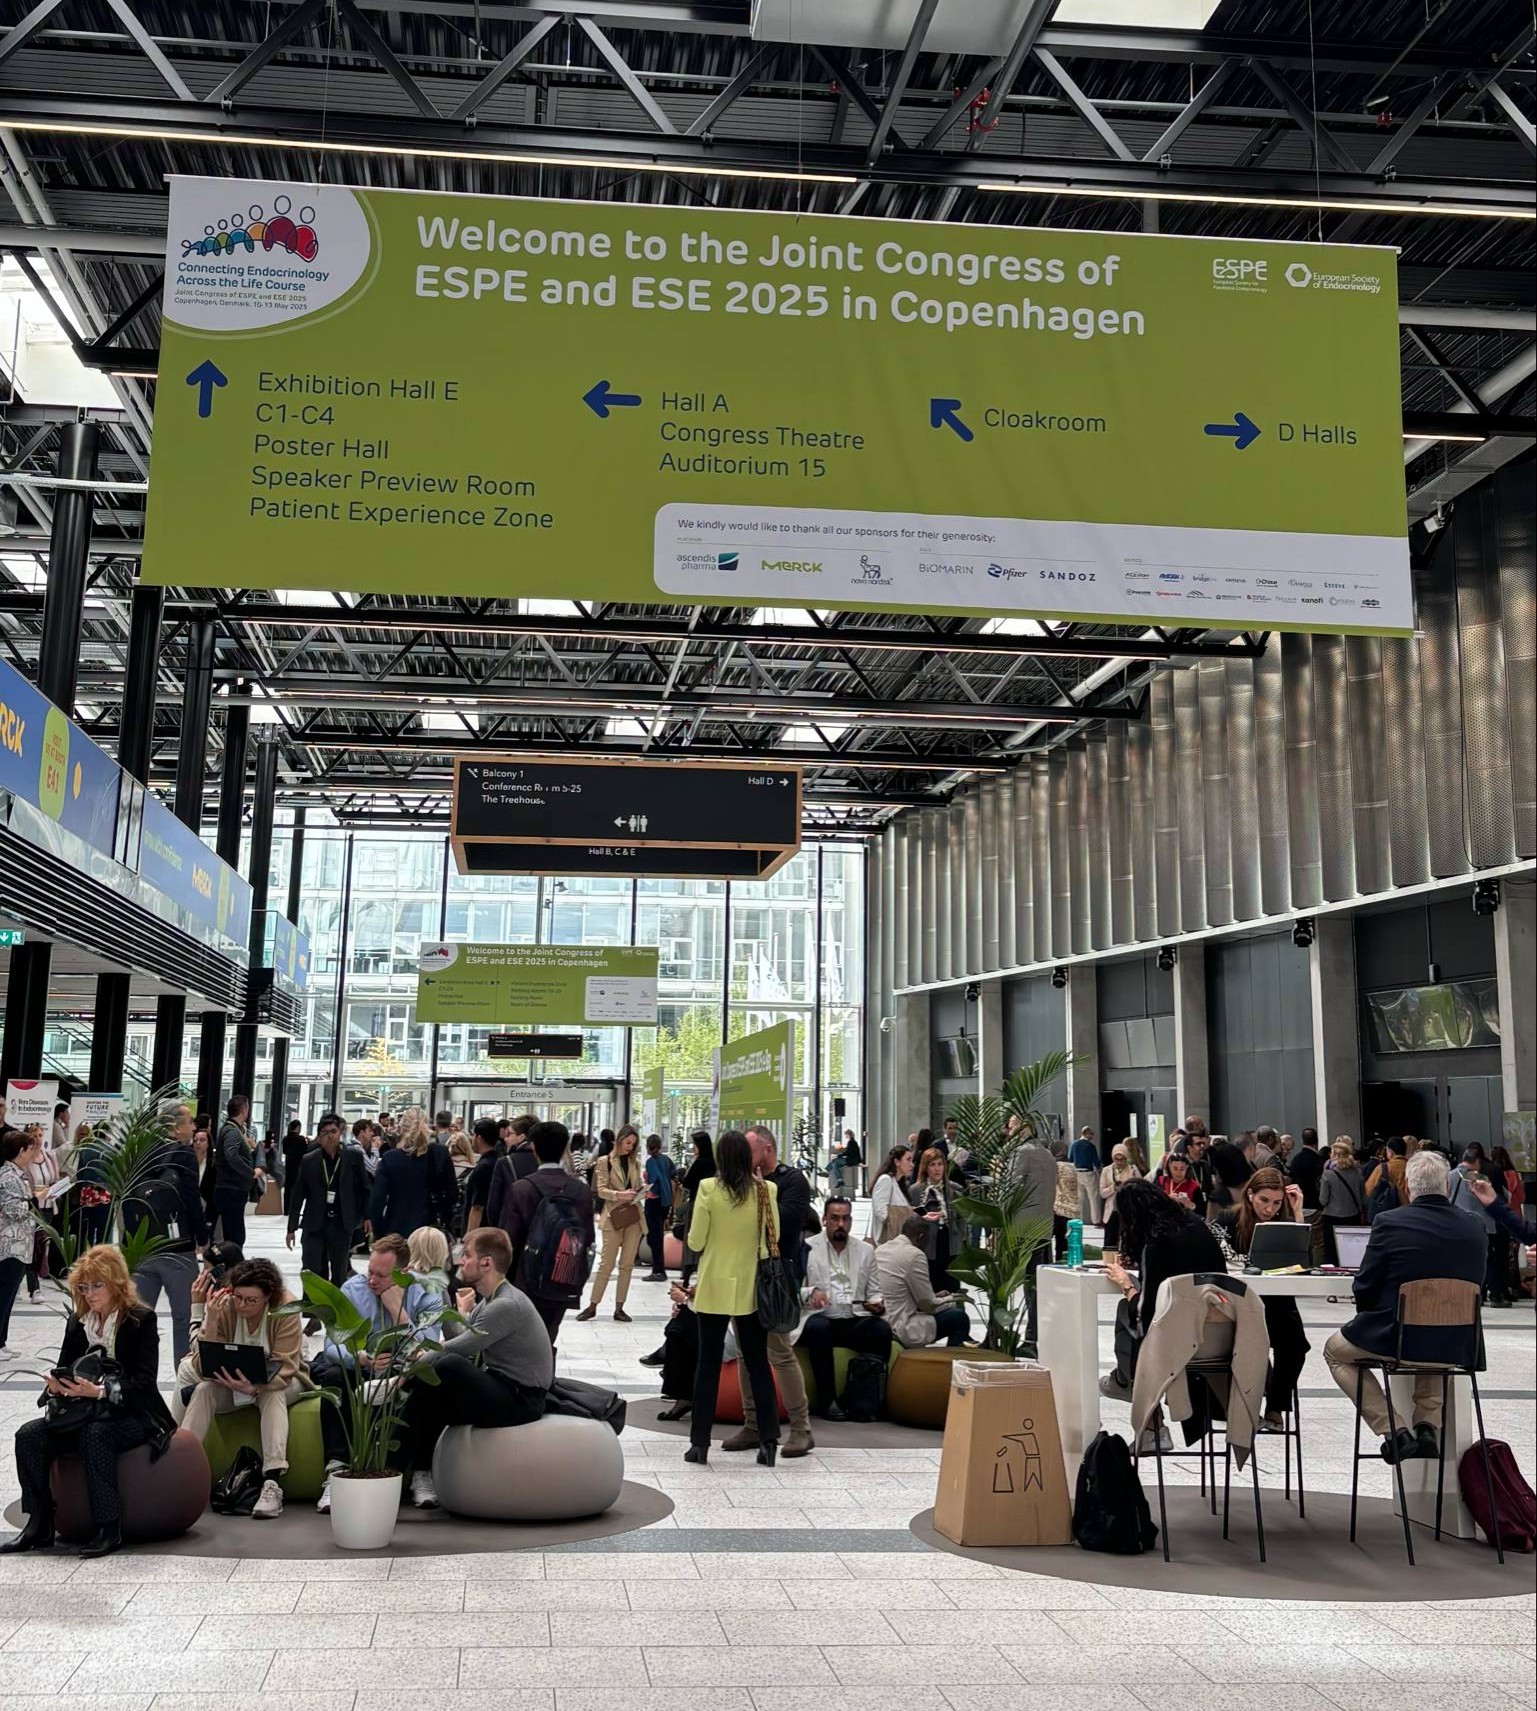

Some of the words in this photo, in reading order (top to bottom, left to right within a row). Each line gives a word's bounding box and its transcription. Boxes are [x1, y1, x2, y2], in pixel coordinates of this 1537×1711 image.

[417, 215, 611, 258] Welcome
[625, 230, 667, 260] to
[681, 231, 748, 265] the
[758, 234, 863, 272] Joint
[876, 242, 1065, 286] Congress
[1078, 254, 1120, 286] of
[177, 262, 245, 277] Connecting
[247, 265, 330, 282] Endocrinology
[1212, 258, 1268, 281] ESPE
[176, 274, 217, 288] Across
[218, 277, 239, 289] the
[241, 278, 264, 290] Life
[266, 279, 306, 292] Course
[1313, 272, 1350, 283] European
[1351, 274, 1380, 285] Society
[1313, 281, 1321, 289] of
[1323, 281, 1381, 294] Endocrinology
[175, 289, 193, 297] Joint
[195, 289, 229, 299] Congress
[238, 292, 257, 300] ESPE
[258, 293, 272, 301] and
[273, 293, 287, 301] ESE
[288, 294, 307, 302] 2025
[274, 302, 289, 310] May
[415, 265, 528, 302] ESPE
[540, 275, 617, 306] and
[632, 276, 712, 312] ESE
[725, 281, 829, 316] 2025
[843, 286, 877, 321] in
[890, 290, 1145, 340] Copenhagen
[258, 372, 381, 397] Exhibition
[391, 379, 435, 400] Hall
[445, 382, 459, 401] E
[662, 392, 705, 412] Hall
[712, 394, 729, 413] A
[256, 403, 335, 425] C1-C4
[984, 408, 1106, 432] Cloakroom
[660, 422, 769, 447] Congress
[775, 427, 865, 450] Theatre
[1278, 423, 1294, 442] D
[1303, 424, 1357, 445] Halls
[255, 434, 335, 457] Poster
[343, 438, 389, 459] Hall
[659, 452, 789, 476] Auditorium
[798, 459, 826, 477] 15
[252, 465, 352, 490] Speaker
[361, 470, 459, 493] Preview
[467, 475, 535, 497] Room
[250, 497, 340, 520] Patient
[349, 501, 485, 526] Experience
[494, 507, 554, 529] Zone
[677, 519, 694, 529] We
[697, 519, 726, 531] kindly
[728, 521, 758, 531] would
[761, 522, 777, 532] like
[780, 524, 791, 532] to
[792, 523, 820, 534] thank
[823, 525, 834, 534] all
[836, 527, 853, 535] our
[855, 527, 899, 538] sponsors
[901, 529, 915, 538] for
[917, 530, 940, 540] their
[942, 532, 996, 543] generosity:
[677, 553, 717, 563] ascendis
[681, 563, 717, 572] pharma
[762, 560, 823, 573] MERCK
[1002, 568, 1028, 581] Pfizer
[1040, 570, 1097, 582] SANDOZ
[482, 769, 517, 780] Balcony
[520, 770, 524, 778] 1
[481, 782, 532, 791] Conference
[749, 777, 764, 786] Hall
[766, 778, 774, 786] D
[481, 794, 498, 803] The
[589, 847, 604, 856] Hall
[466, 946, 504, 955] Welcome
[517, 947, 530, 955] the
[532, 948, 553, 956] Joint
[555, 949, 593, 957] Congress
[594, 949, 604, 957] of
[466, 956, 488, 964] ESPE
[489, 957, 506, 965] and
[507, 957, 524, 965] ESE
[525, 958, 546, 966] 2025
[548, 958, 556, 966] in
[557, 958, 609, 968] Copenhagen
[510, 1090, 546, 1099] Entrance
